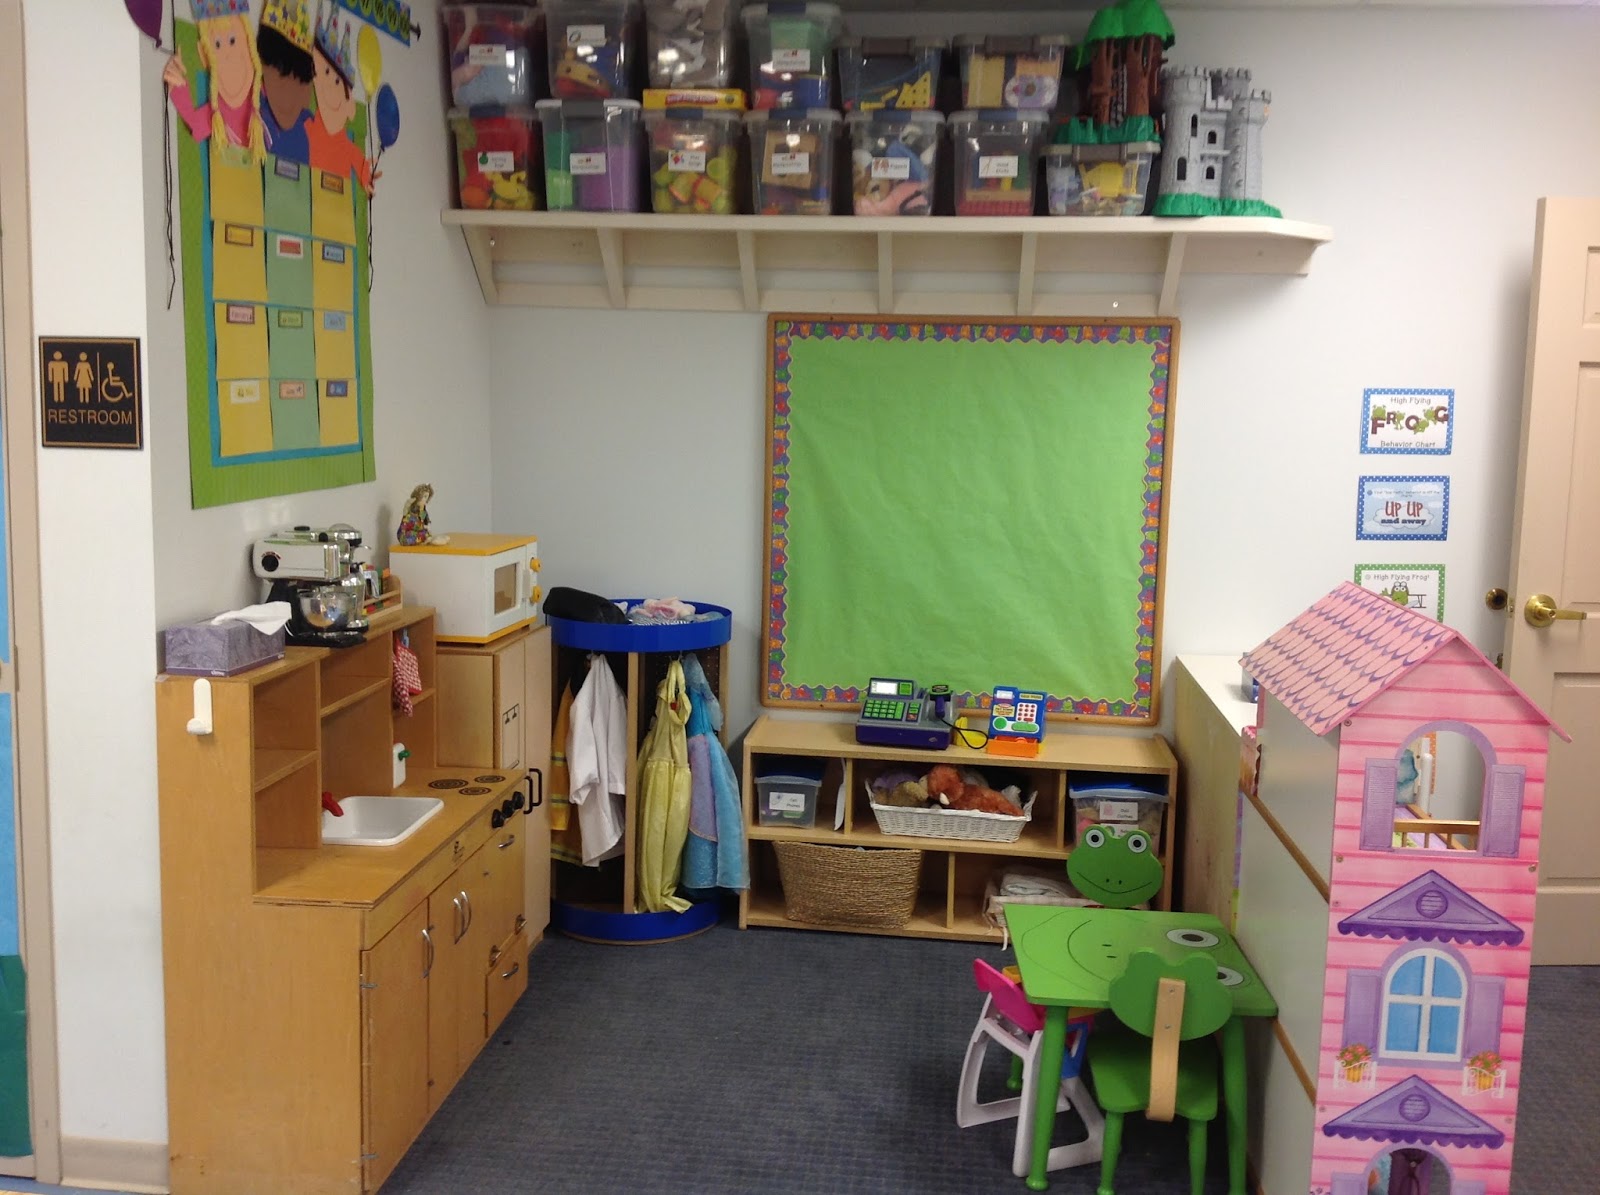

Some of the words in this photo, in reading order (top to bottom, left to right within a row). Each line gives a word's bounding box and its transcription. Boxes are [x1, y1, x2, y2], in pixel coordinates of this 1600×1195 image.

[1390, 396, 1407, 405] High
[1409, 397, 1431, 405] Flying
[48, 409, 133, 425] RESTROOM
[1371, 405, 1449, 435] FROG
[1380, 440, 1412, 448] Behavior
[1385, 500, 1402, 517] UP
[1406, 501, 1424, 518] UP
[1401, 518, 1426, 526] away
